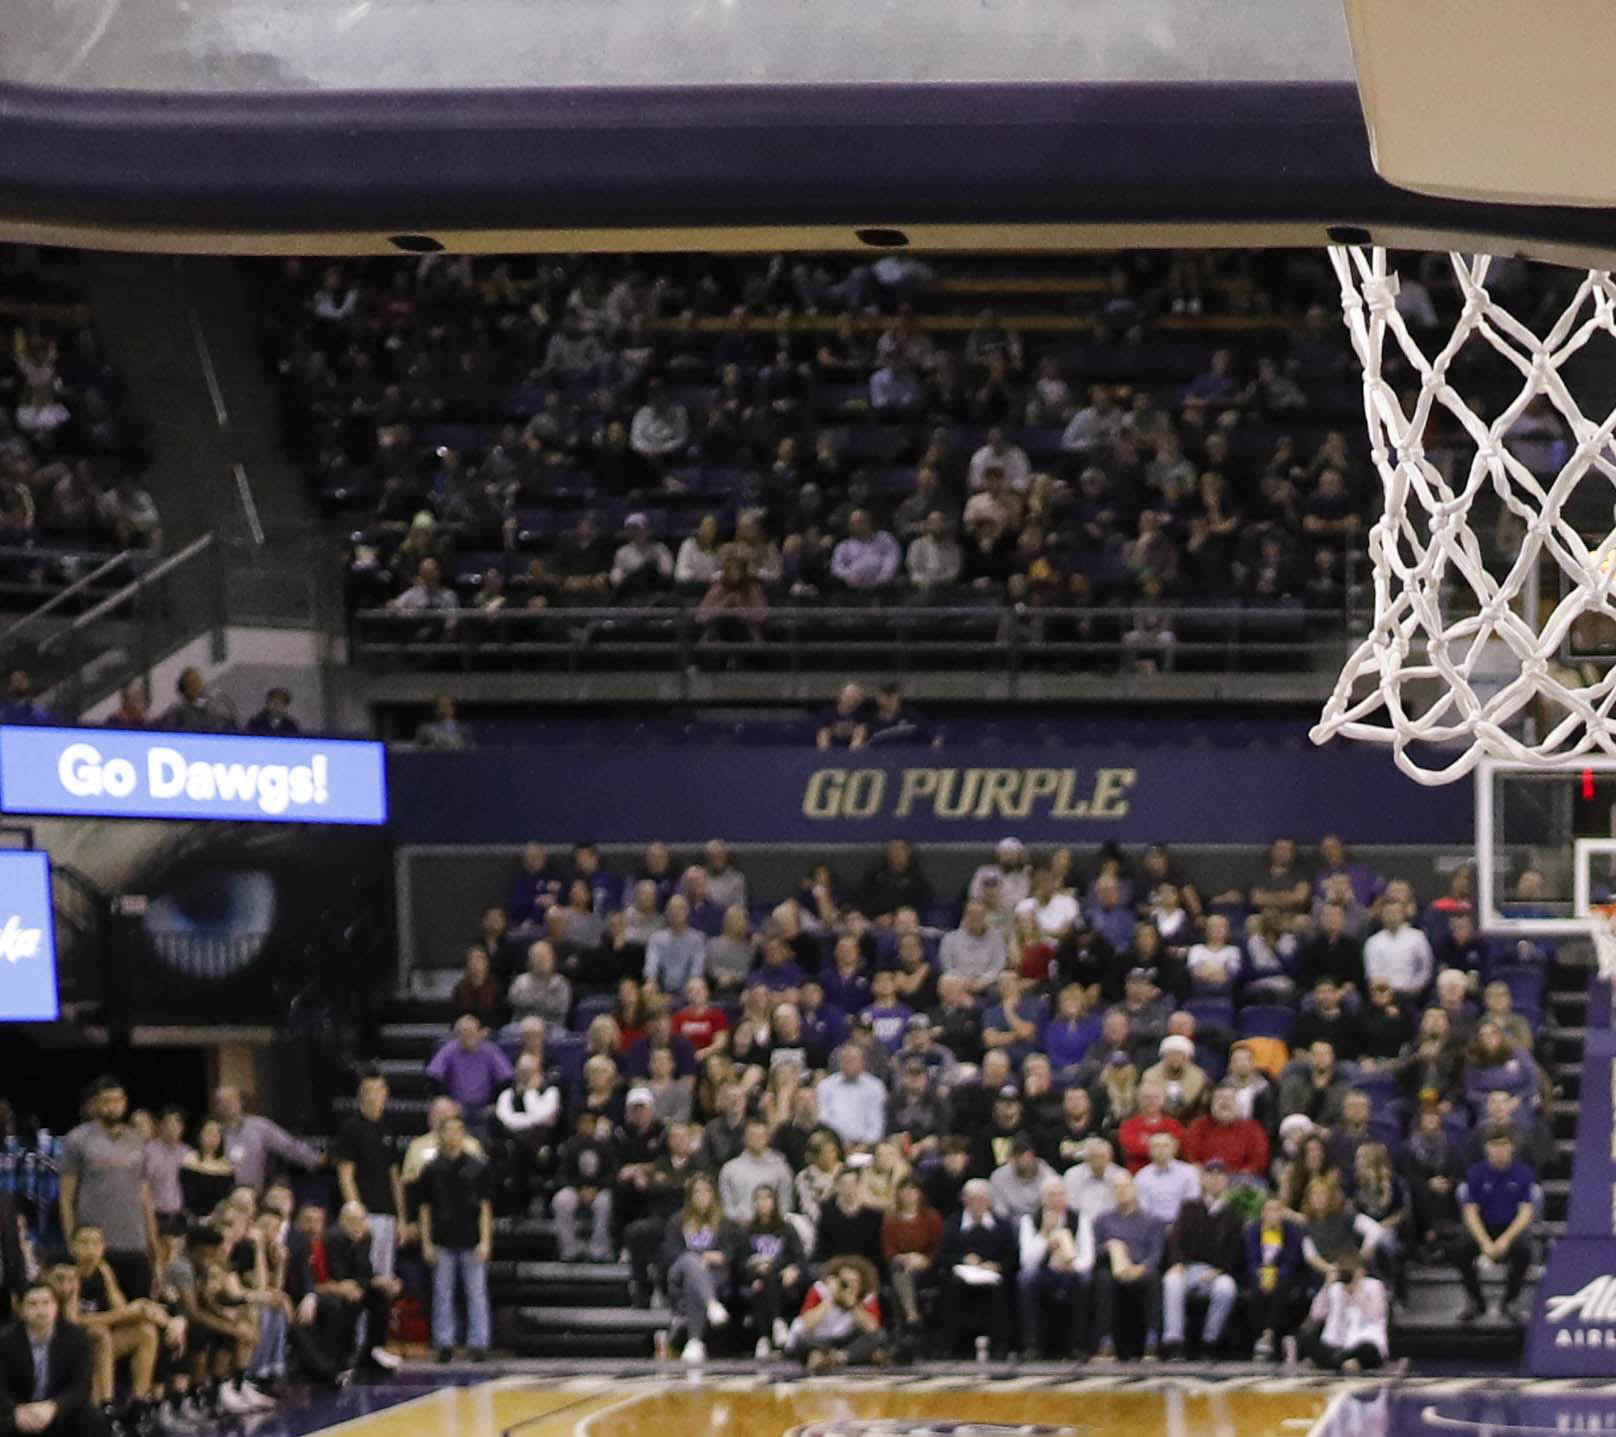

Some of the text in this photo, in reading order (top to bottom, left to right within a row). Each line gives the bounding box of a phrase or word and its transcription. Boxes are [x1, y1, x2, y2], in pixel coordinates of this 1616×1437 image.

[58, 743, 327, 814] Go Dawgs!
[802, 767, 1137, 820] GO PURPLE
